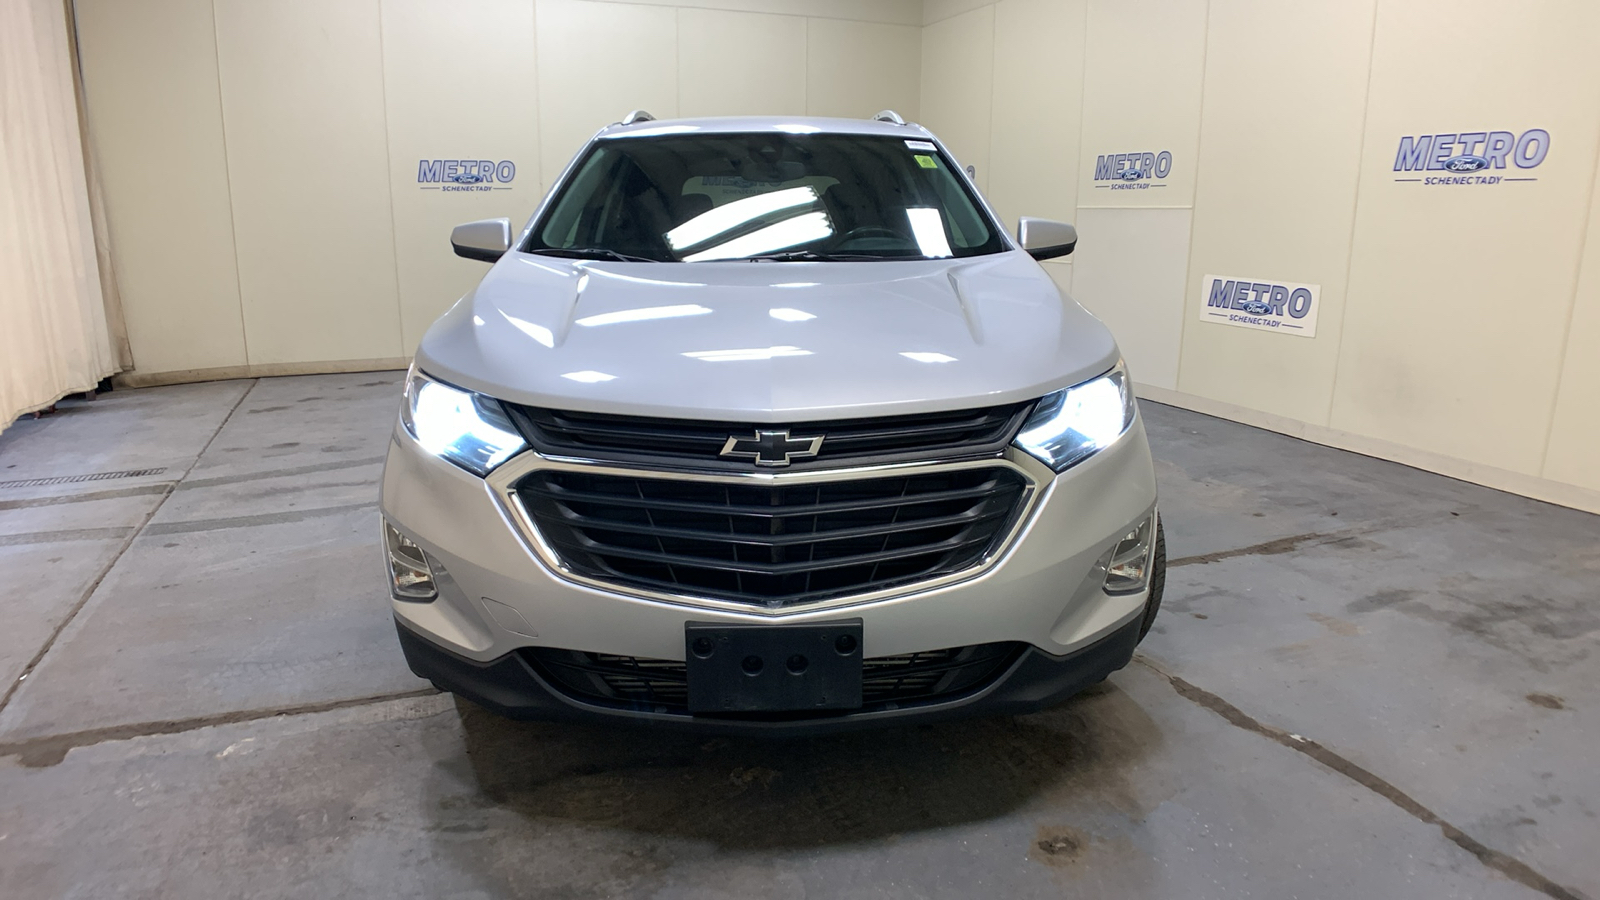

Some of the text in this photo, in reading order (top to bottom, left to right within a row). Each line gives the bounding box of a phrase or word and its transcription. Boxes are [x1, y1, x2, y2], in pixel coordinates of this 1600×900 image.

[1393, 128, 1551, 172] METRO
[418, 160, 516, 183] METRO
[1094, 150, 1173, 181] METRO
[1450, 159, 1480, 171] Ford
[1424, 176, 1504, 185] SCHENECTADY
[1207, 279, 1312, 319] METRO
[1246, 303, 1268, 315] Ford
[1229, 314, 1282, 328] SCHENECTADY
